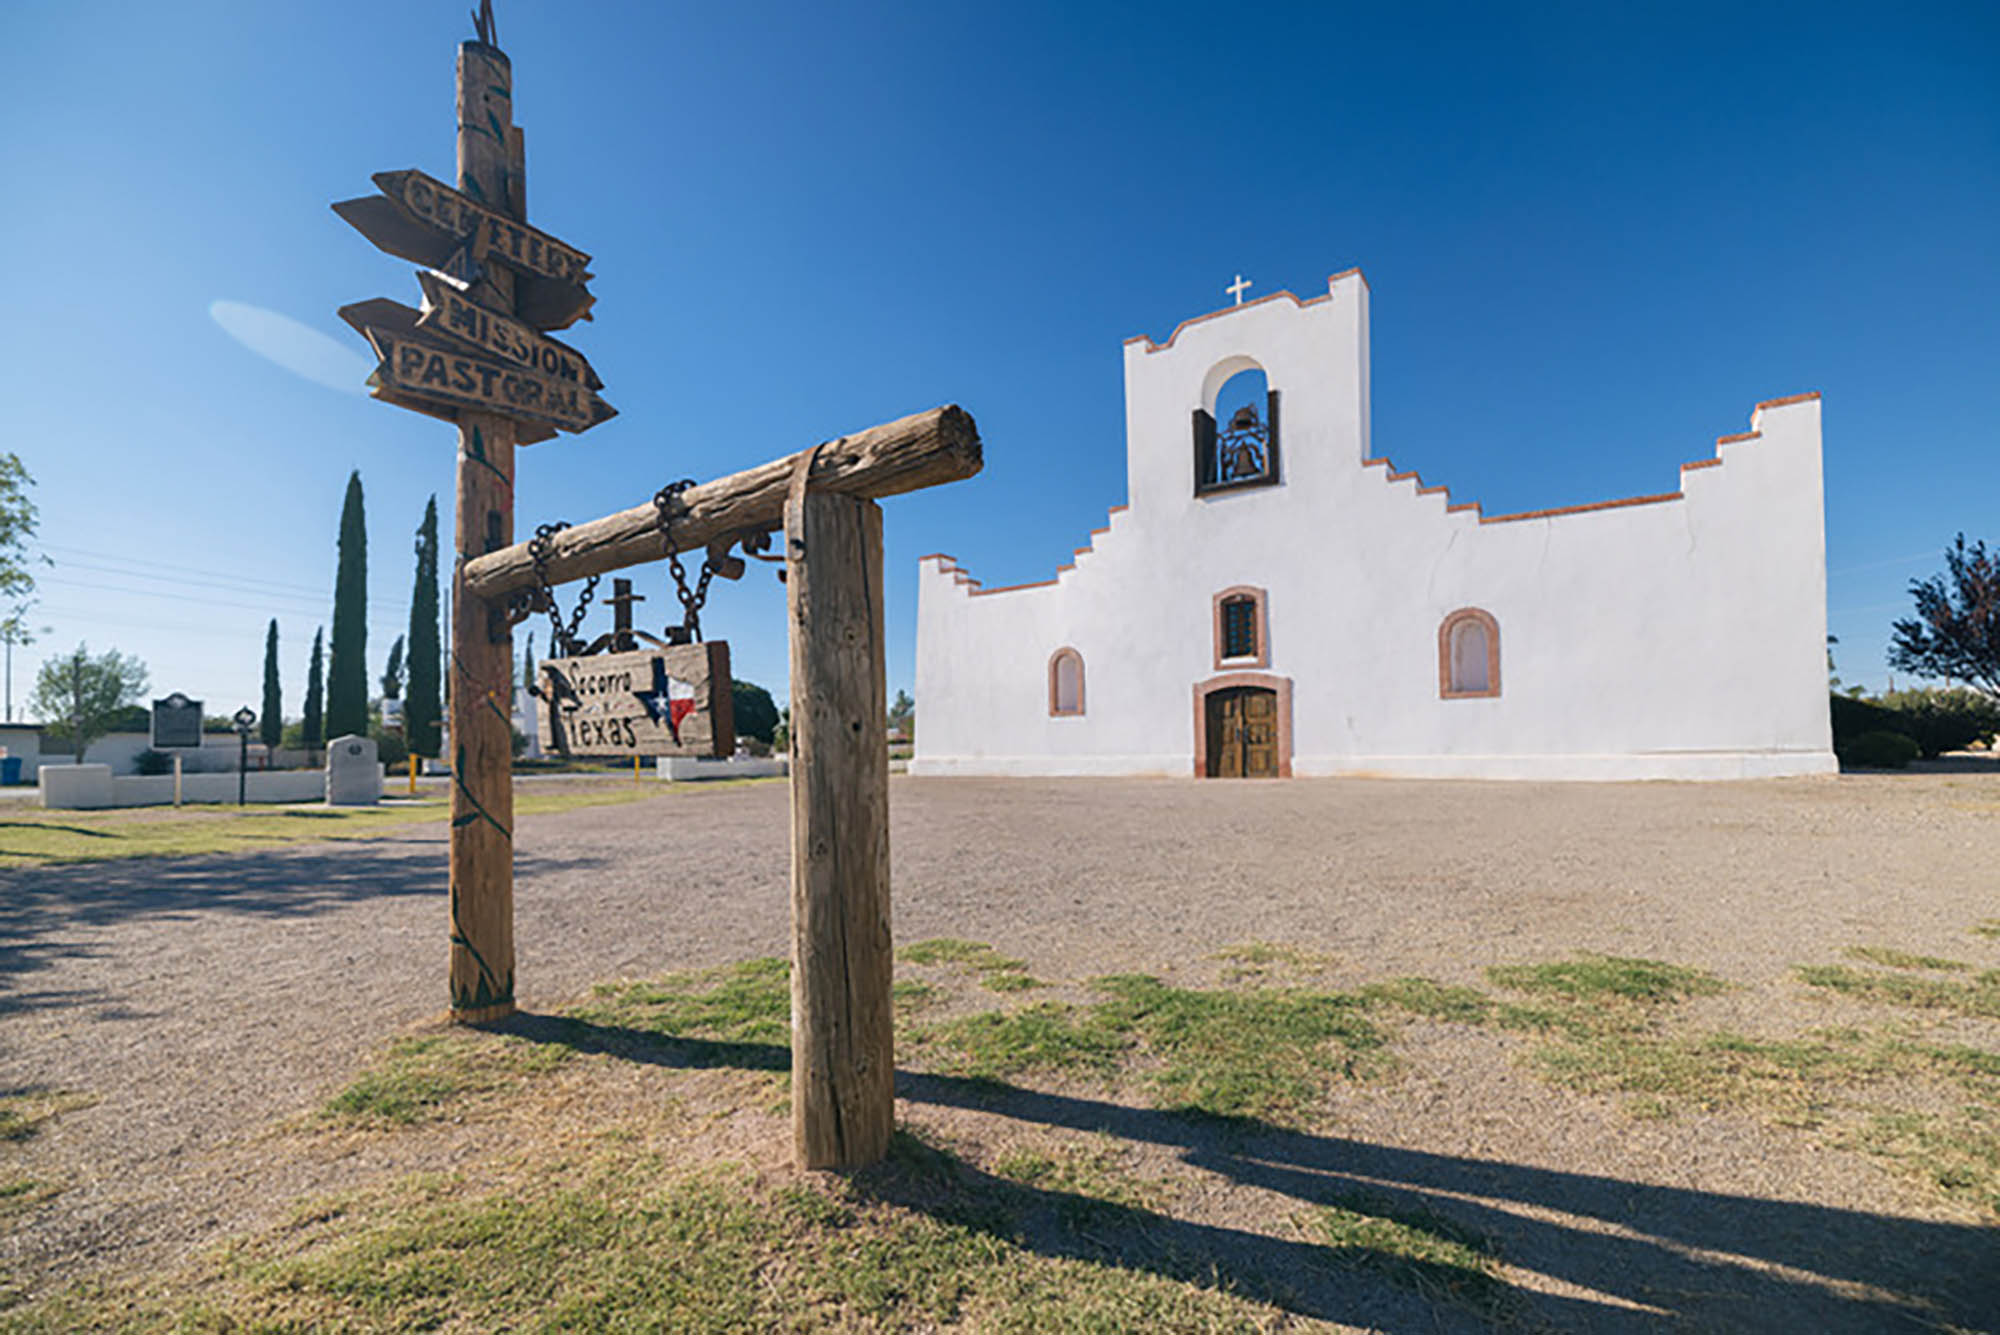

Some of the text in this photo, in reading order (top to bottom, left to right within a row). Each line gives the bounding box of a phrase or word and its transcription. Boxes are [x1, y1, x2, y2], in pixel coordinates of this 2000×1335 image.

[449, 293, 580, 383] MISSION
[400, 345, 588, 420] PASTORAL
[568, 661, 631, 695] Socorro
[562, 706, 636, 748] Texas
